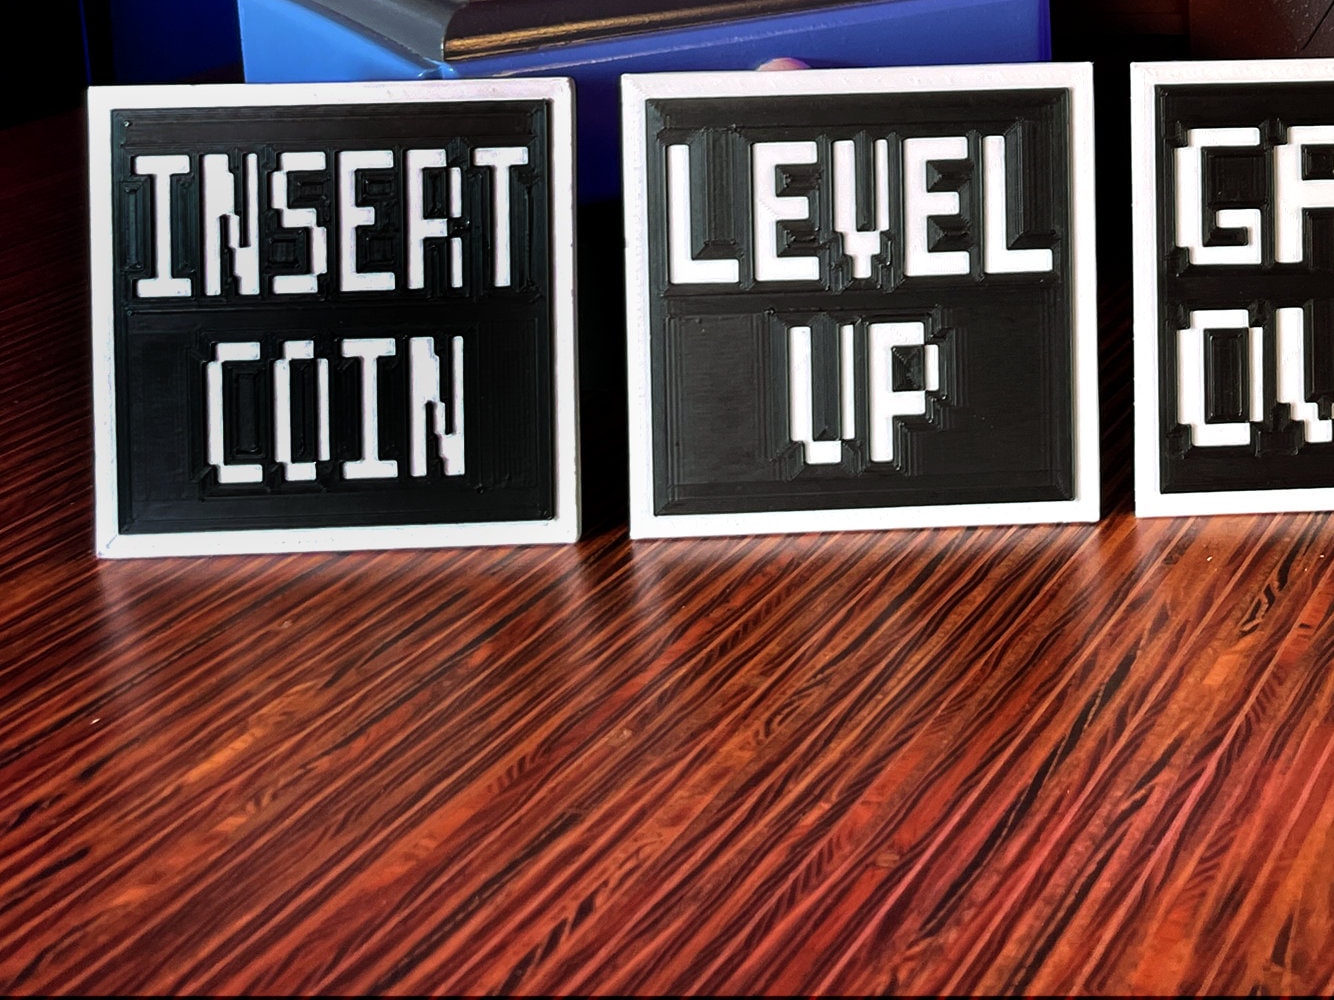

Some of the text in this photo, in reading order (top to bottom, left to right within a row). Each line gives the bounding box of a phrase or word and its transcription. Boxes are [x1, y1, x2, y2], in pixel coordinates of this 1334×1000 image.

[134, 147, 529, 298] INSERT
[668, 135, 1053, 284] LEVEL
[207, 336, 465, 483] COIN
[789, 322, 940, 464] UP
